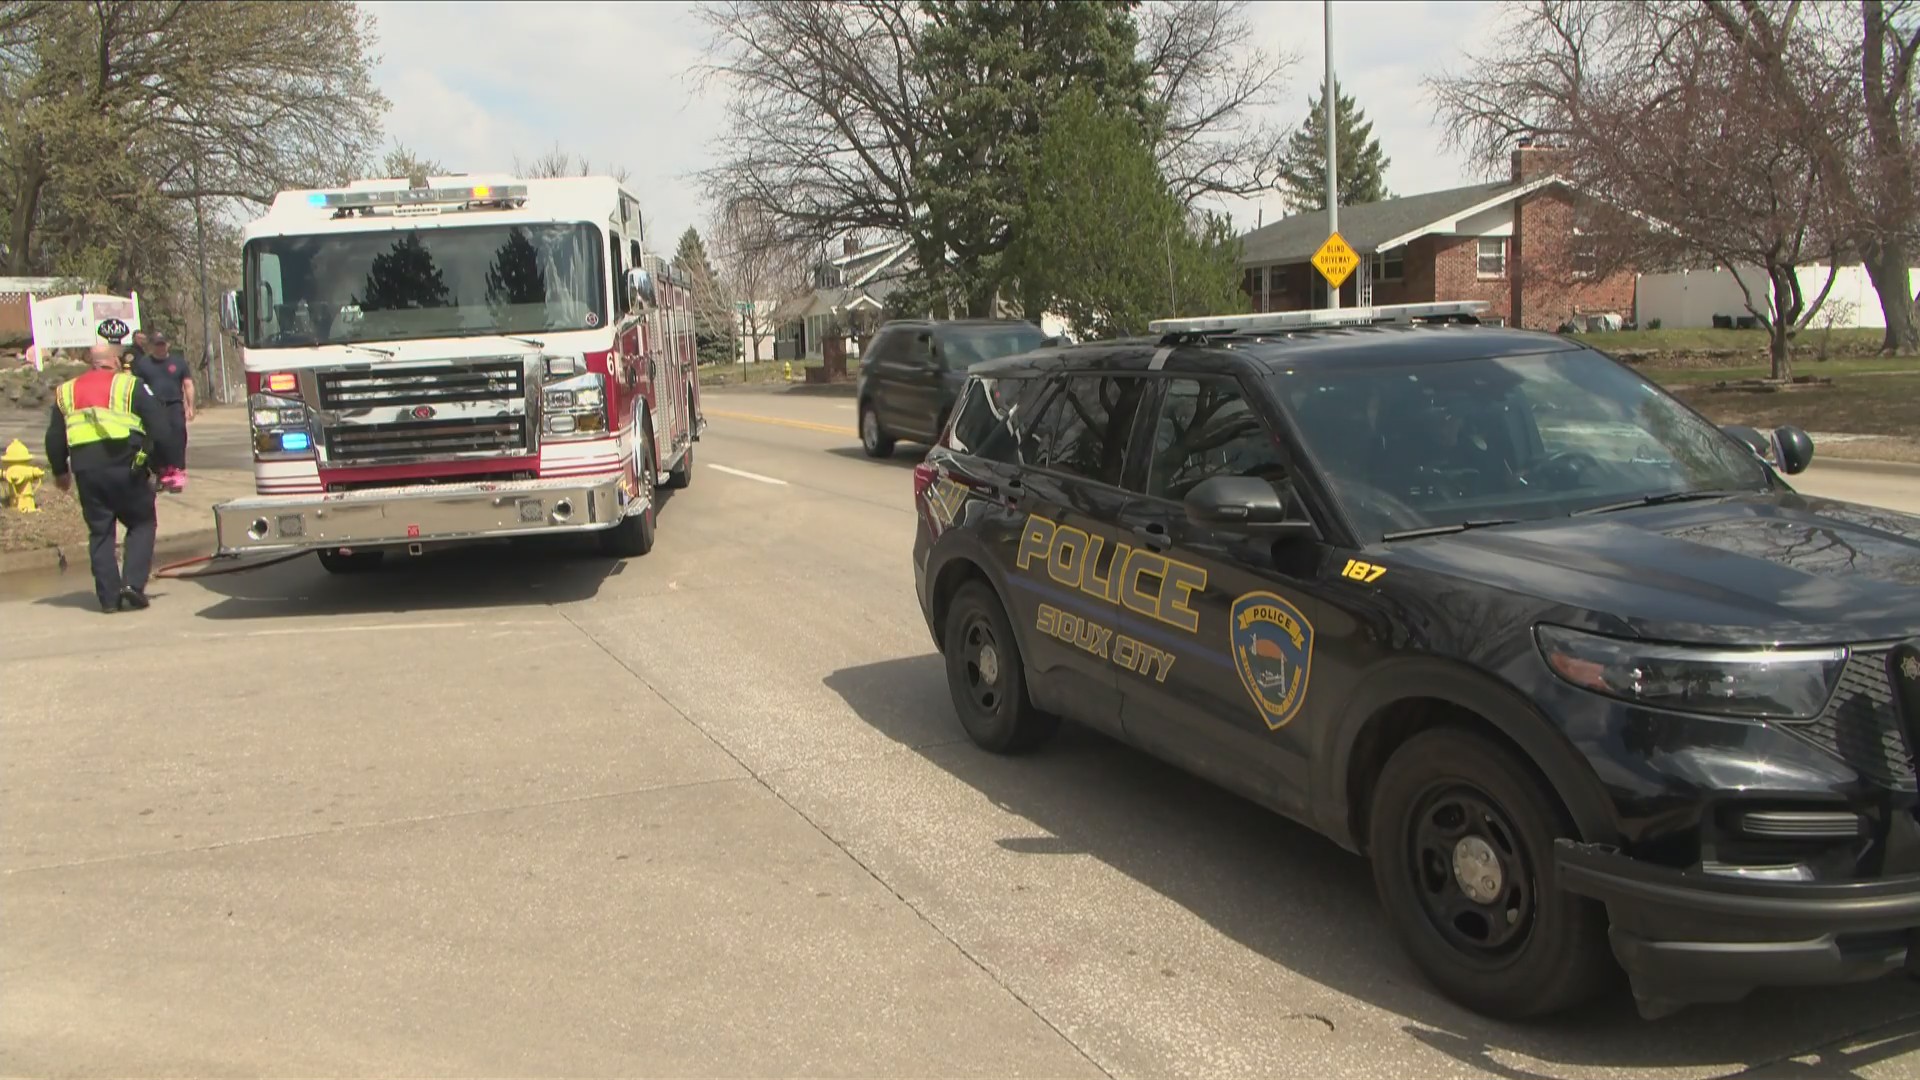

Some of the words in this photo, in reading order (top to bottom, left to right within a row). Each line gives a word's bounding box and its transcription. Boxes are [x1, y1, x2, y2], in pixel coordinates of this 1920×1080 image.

[1320, 256, 1350, 264] DRIVEWAY
[1326, 245, 1345, 253] BLIND
[1326, 267, 1347, 275] AHEAD
[606, 352, 615, 376] 6
[1016, 513, 1208, 633] POLICE
[1341, 559, 1387, 583] 187
[1253, 608, 1292, 630] POLICE
[1036, 603, 1113, 659] SIOUX
[1112, 634, 1176, 682] CITY
